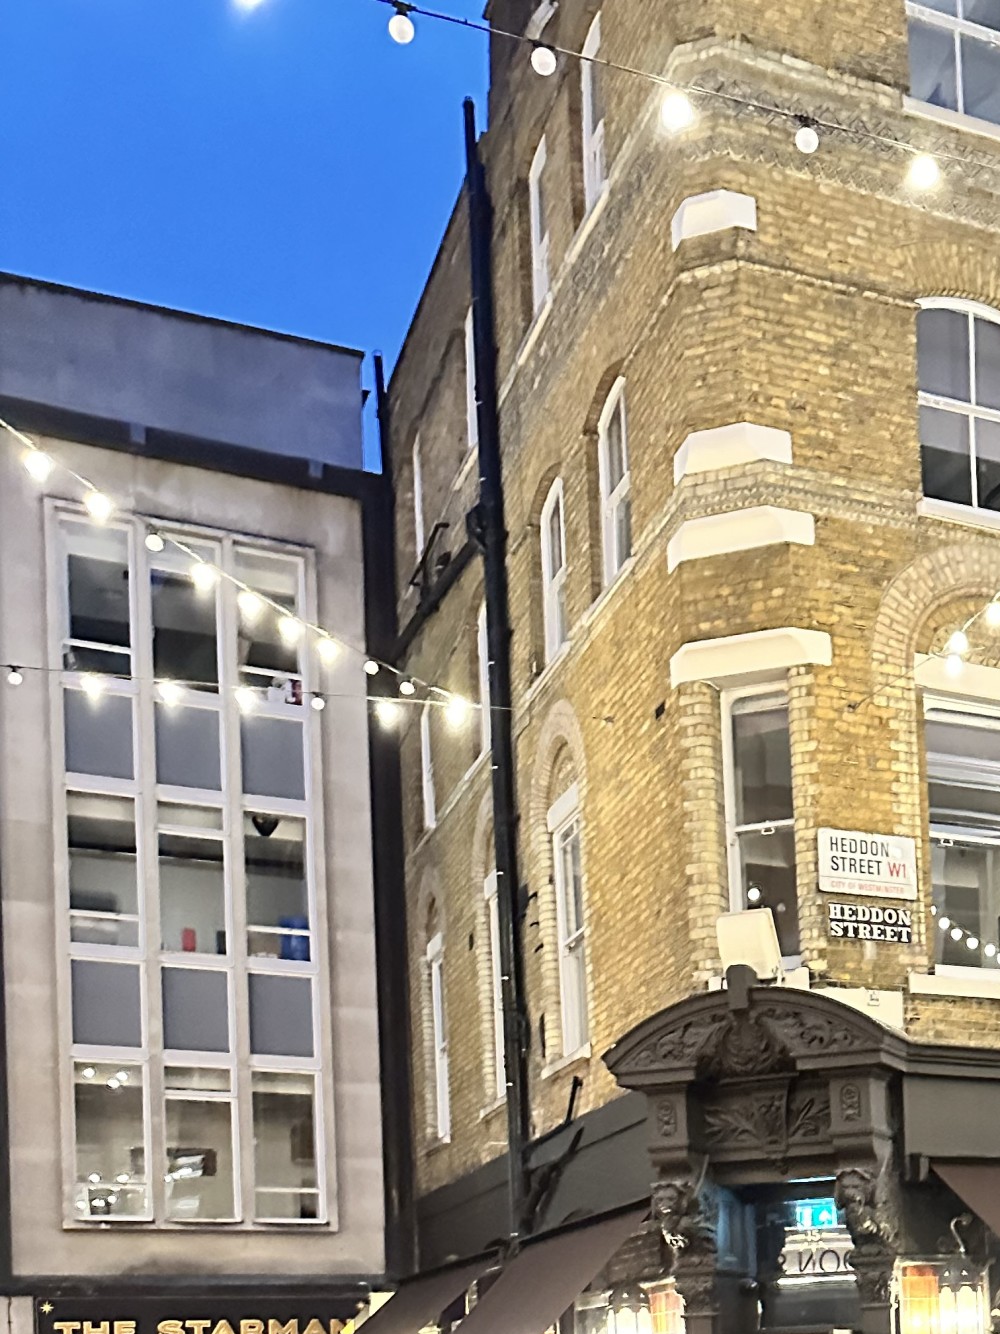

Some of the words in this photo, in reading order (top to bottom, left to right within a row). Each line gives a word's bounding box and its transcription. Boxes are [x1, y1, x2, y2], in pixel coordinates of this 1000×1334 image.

[830, 836, 889, 857] HEDDON
[831, 855, 882, 875] STREET
[888, 862, 906, 878] W1
[831, 881, 846, 889] CITY
[848, 881, 855, 889] OF
[858, 882, 904, 894] WESTMINSTER
[828, 903, 911, 926] HEDDON
[830, 921, 911, 942] STREET
